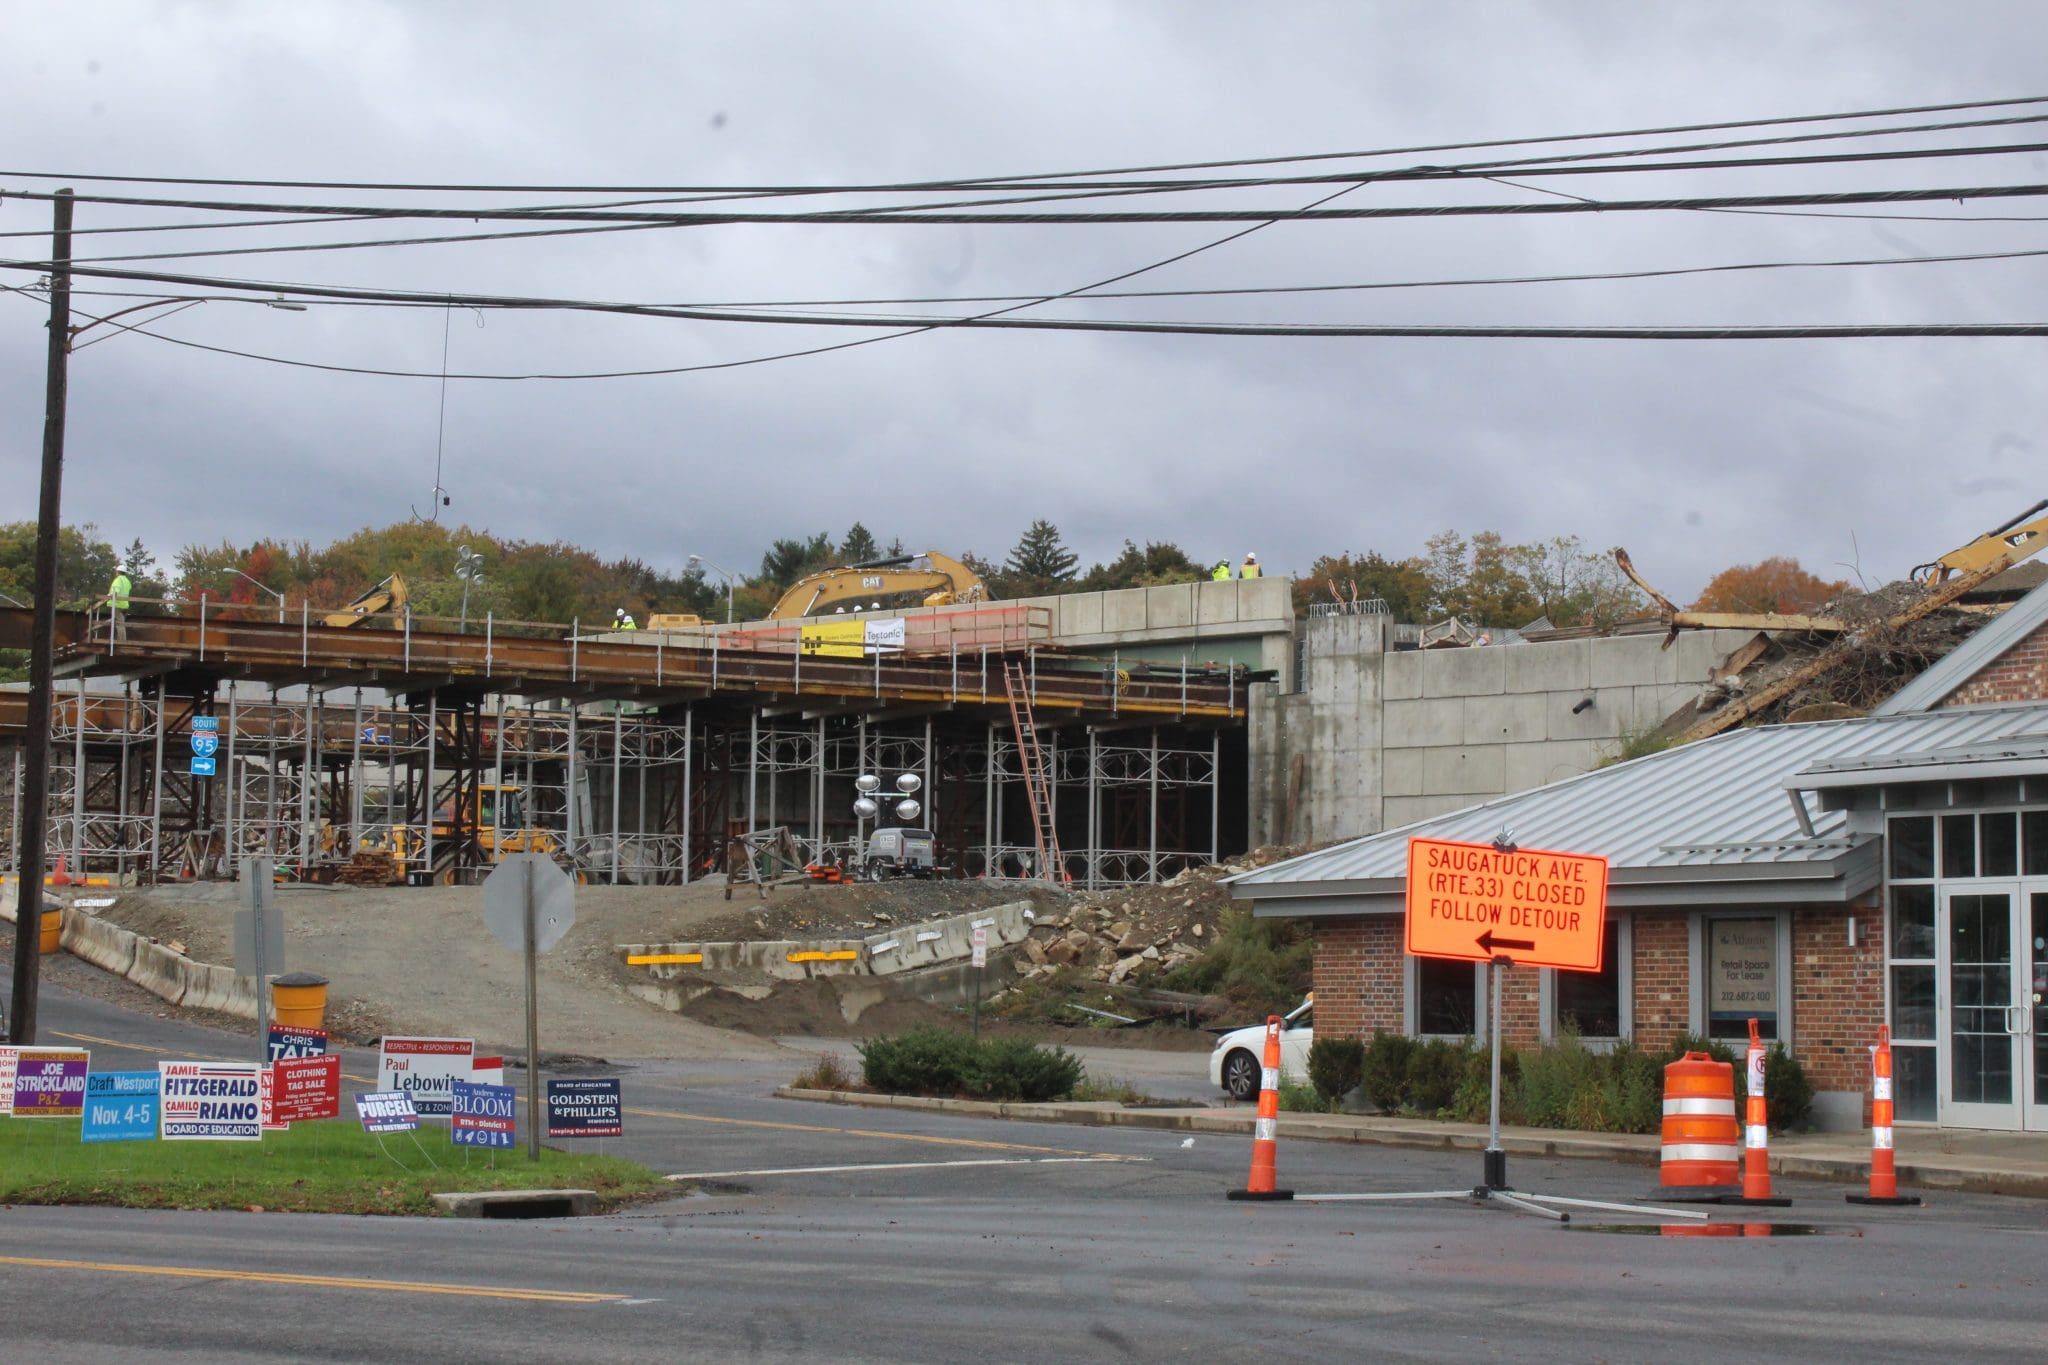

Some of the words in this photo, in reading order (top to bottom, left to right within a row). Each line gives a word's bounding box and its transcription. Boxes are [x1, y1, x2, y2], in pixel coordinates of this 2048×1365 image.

[2013, 532, 2029, 546] CAT
[863, 576, 881, 588] CAT
[867, 627, 902, 640] Tectonic
[193, 719, 217, 728] SOUTH
[195, 739, 214, 753] 95
[1428, 848, 1540, 878] SAUGATUCK
[1548, 861, 1588, 883] AVE.
[1428, 872, 1504, 898] (RTE.33)
[1513, 881, 1585, 906] CLOSED
[1431, 898, 1502, 924] FOLLOW
[1510, 907, 1580, 932] DETOUR
[1721, 960, 1742, 970] Retail
[1745, 960, 1770, 972] Space
[1727, 971, 1738, 980] For
[1740, 971, 1765, 980] Lease
[284, 1027, 314, 1035] RE-ELECT
[282, 1035, 313, 1046] CHRIS
[269, 1043, 324, 1062] TAIT
[387, 1043, 418, 1051] RESPECTFUL
[423, 1043, 455, 1052] RESPONSIVE
[459, 1044, 471, 1052] FAIR
[41, 1063, 64, 1075] JOE
[166, 1066, 198, 1075] JAMIE
[385, 1058, 409, 1071] Paul
[287, 1068, 327, 1079] CLOTHING
[16, 1075, 85, 1092] STRICKLAND
[88, 1076, 159, 1092] CraftWestport
[165, 1079, 258, 1096] FITZGERALD
[288, 1082, 303, 1091] TAG
[305, 1080, 326, 1089] SALE
[393, 1073, 464, 1091] Lebowit
[472, 1088, 494, 1097] Andrew
[453, 1095, 512, 1116] BLOOM
[550, 1095, 618, 1105] GOLDSTEIN
[166, 1101, 199, 1111] CAMILO
[199, 1102, 258, 1120] RIANO
[357, 1099, 417, 1118] PURCELL
[92, 1105, 120, 1126] Nov.
[124, 1104, 150, 1125] 4-5
[166, 1124, 197, 1134] BOARD
[198, 1124, 210, 1134] OF
[211, 1125, 258, 1135] EDUCATION
[383, 1123, 411, 1131] DISTRICT
[479, 1120, 502, 1129] District
